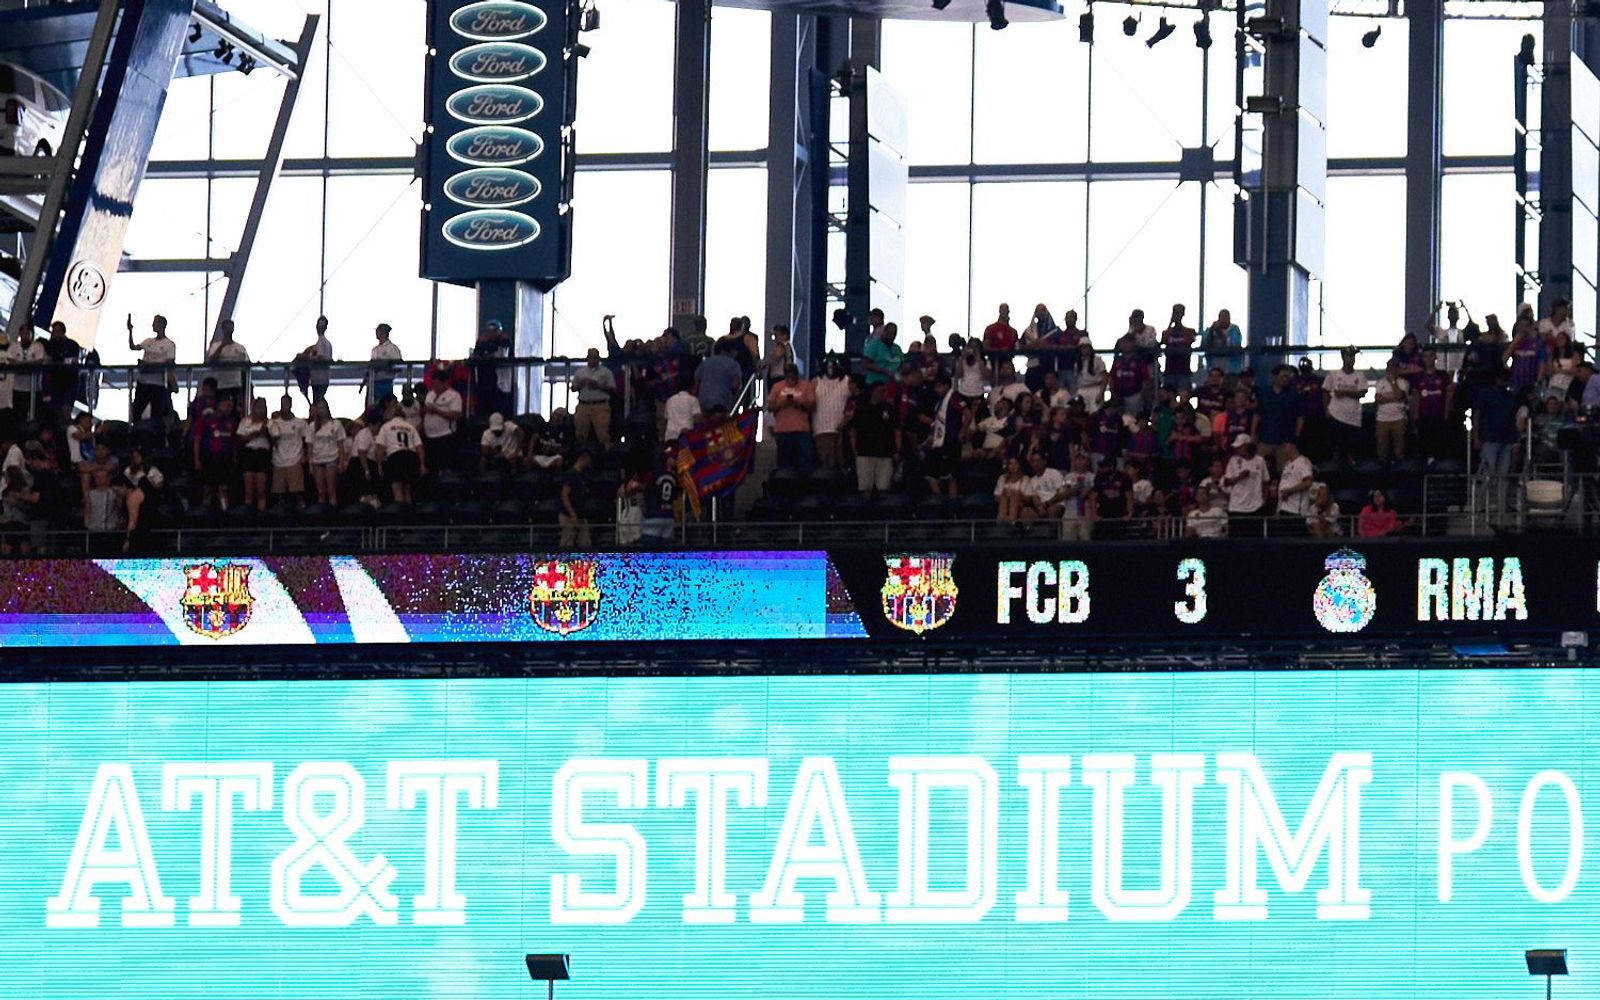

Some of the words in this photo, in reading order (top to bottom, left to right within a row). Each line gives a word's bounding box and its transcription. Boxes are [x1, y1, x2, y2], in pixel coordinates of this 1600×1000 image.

[471, 9, 525, 32] Ford
[471, 50, 525, 74] Ford
[467, 92, 521, 116] Ford
[467, 134, 521, 157] Ford
[465, 174, 519, 199] Ford
[464, 217, 518, 240] Ford
[397, 431, 408, 447] 9
[661, 481, 672, 502] 9
[997, 560, 1091, 625] FCB
[1175, 558, 1208, 624] 3
[1417, 557, 1528, 622] RMA
[47, 760, 497, 926] AT&T
[551, 753, 1372, 925] STADIUM
